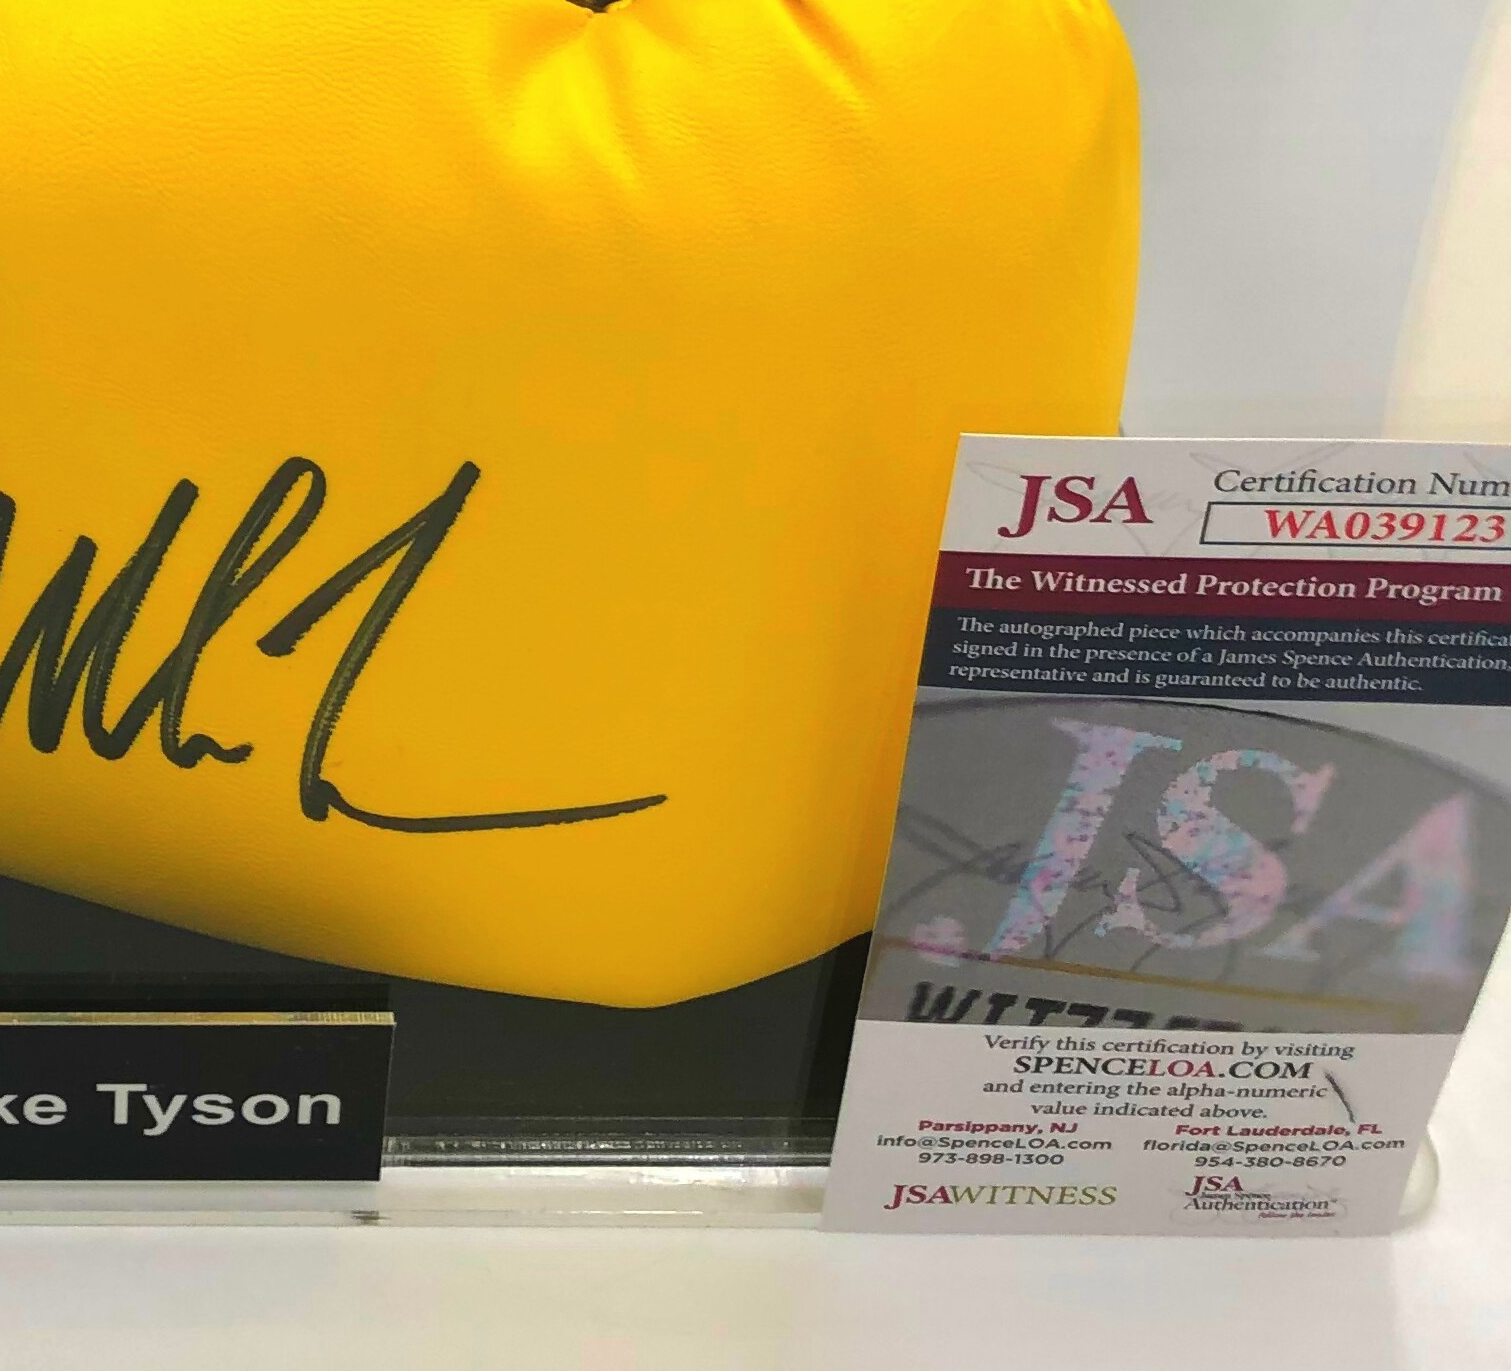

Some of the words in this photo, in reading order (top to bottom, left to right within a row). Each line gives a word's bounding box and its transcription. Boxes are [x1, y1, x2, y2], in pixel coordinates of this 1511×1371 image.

[1213, 468, 1417, 496] Certification
[997, 474, 1154, 538] JSA
[1264, 509, 1506, 543] WA039123
[965, 567, 1021, 591] The
[1031, 569, 1188, 595] Witnessed
[1194, 572, 1357, 600] Protection
[1365, 576, 1503, 607] Program
[957, 616, 993, 634] The
[999, 619, 1124, 641] autographed
[1129, 624, 1181, 642] piece
[1187, 624, 1246, 641] which
[1251, 627, 1380, 647] accompanies
[1386, 628, 1424, 645] this
[952, 641, 1018, 659] signed
[1023, 643, 1043, 658] in
[1049, 643, 1081, 660] the
[1084, 647, 1172, 665] presence
[1176, 646, 1201, 663] of
[1201, 652, 1213, 663] a
[1217, 648, 1277, 666] James
[1281, 649, 1354, 669] Spence
[948, 663, 1088, 682] representative
[1091, 667, 1130, 684] and
[1135, 669, 1151, 685] is
[1155, 671, 1266, 689] guaranteed
[1272, 674, 1292, 689] to
[1296, 673, 1321, 690] be
[1325, 674, 1425, 692] authentic.
[909, 715, 1480, 979] JSA
[983, 1033, 1050, 1053] Verify
[1056, 1035, 1096, 1052] this
[1101, 1037, 1235, 1056] certification
[1241, 1040, 1268, 1060] by
[1274, 1042, 1356, 1060] visiting
[1013, 1055, 1314, 1080] SPENCELOA.COM
[982, 1079, 1023, 1095] and
[1029, 1081, 1120, 1099] entering
[1126, 1080, 1161, 1097] the
[1166, 1081, 1328, 1100] alpha-numeric
[95, 1082, 343, 1137] Tyson
[1030, 1101, 1087, 1116] value
[1093, 1101, 1193, 1118] indicated
[1199, 1103, 1268, 1120] above.
[917, 1119, 1044, 1135] Parsippany,
[1049, 1121, 1079, 1133] NJ
[1174, 1124, 1221, 1136] Fort
[1226, 1124, 1351, 1137] Lauderdale,
[1356, 1123, 1383, 1135] FL
[876, 1134, 1112, 1150] info@SpenceLOA.com
[1143, 1138, 1406, 1155] florida@SpenceLOA.com
[917, 1152, 1065, 1166] 973-898-1300
[1194, 1154, 1347, 1168] 954-380-8670
[1185, 1175, 1244, 1197] JSA
